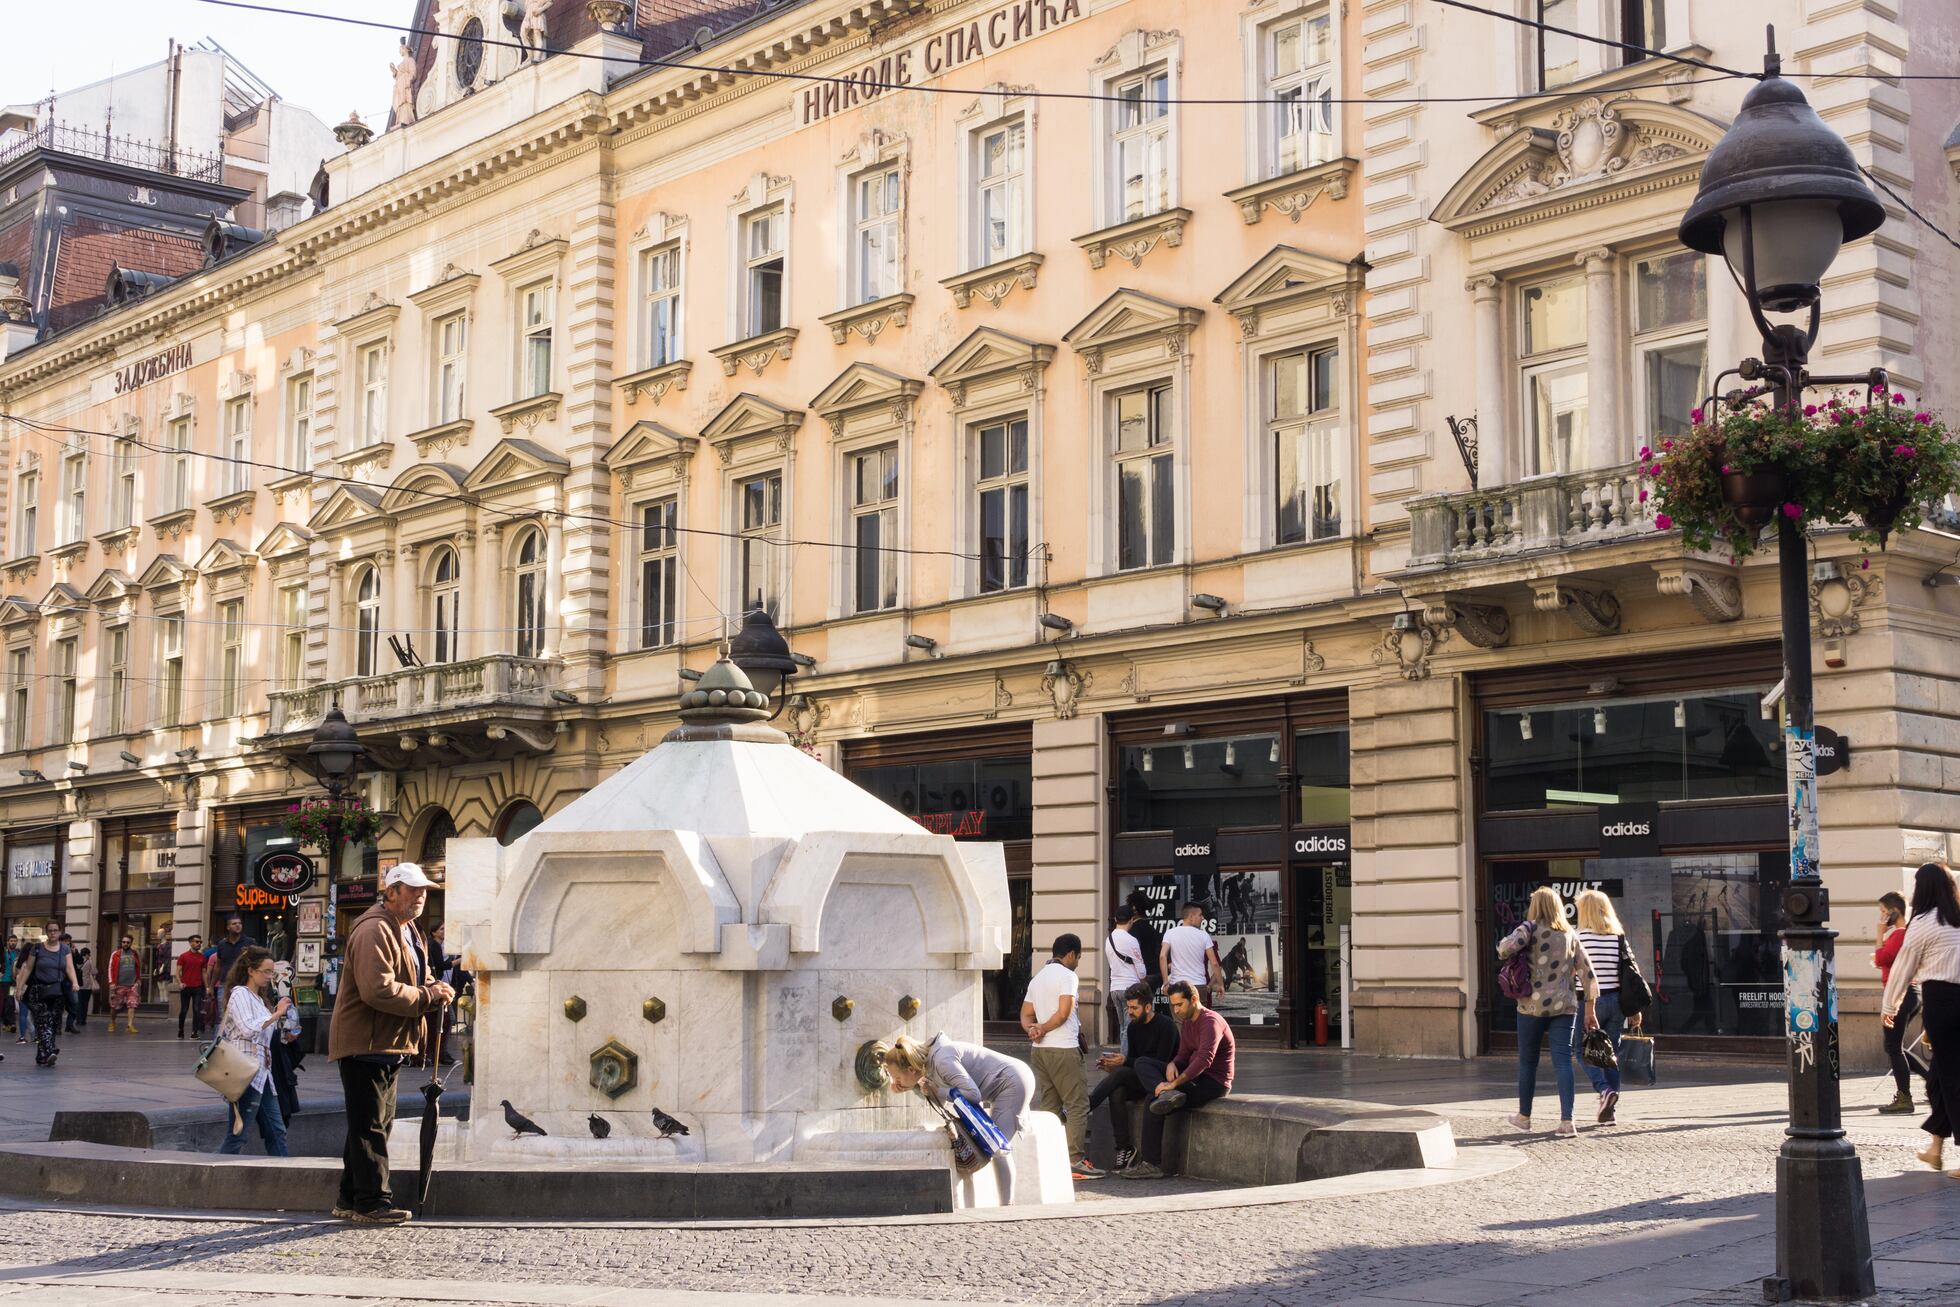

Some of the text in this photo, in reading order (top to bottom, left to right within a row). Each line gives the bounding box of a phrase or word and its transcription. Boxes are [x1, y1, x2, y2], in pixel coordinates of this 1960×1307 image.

[803, 0, 1081, 124] НИКОЛЕ СПАСИЋА
[114, 342, 193, 394] ЗАДУЖБИНА
[1602, 821, 1650, 837] adidas
[1175, 843, 1211, 856] adidas
[1295, 836, 1346, 853] adidas
[1138, 886, 1178, 900] UILT
[1325, 870, 1334, 924] PUREBOOST
[1738, 992, 1767, 1001] FREELIFT
